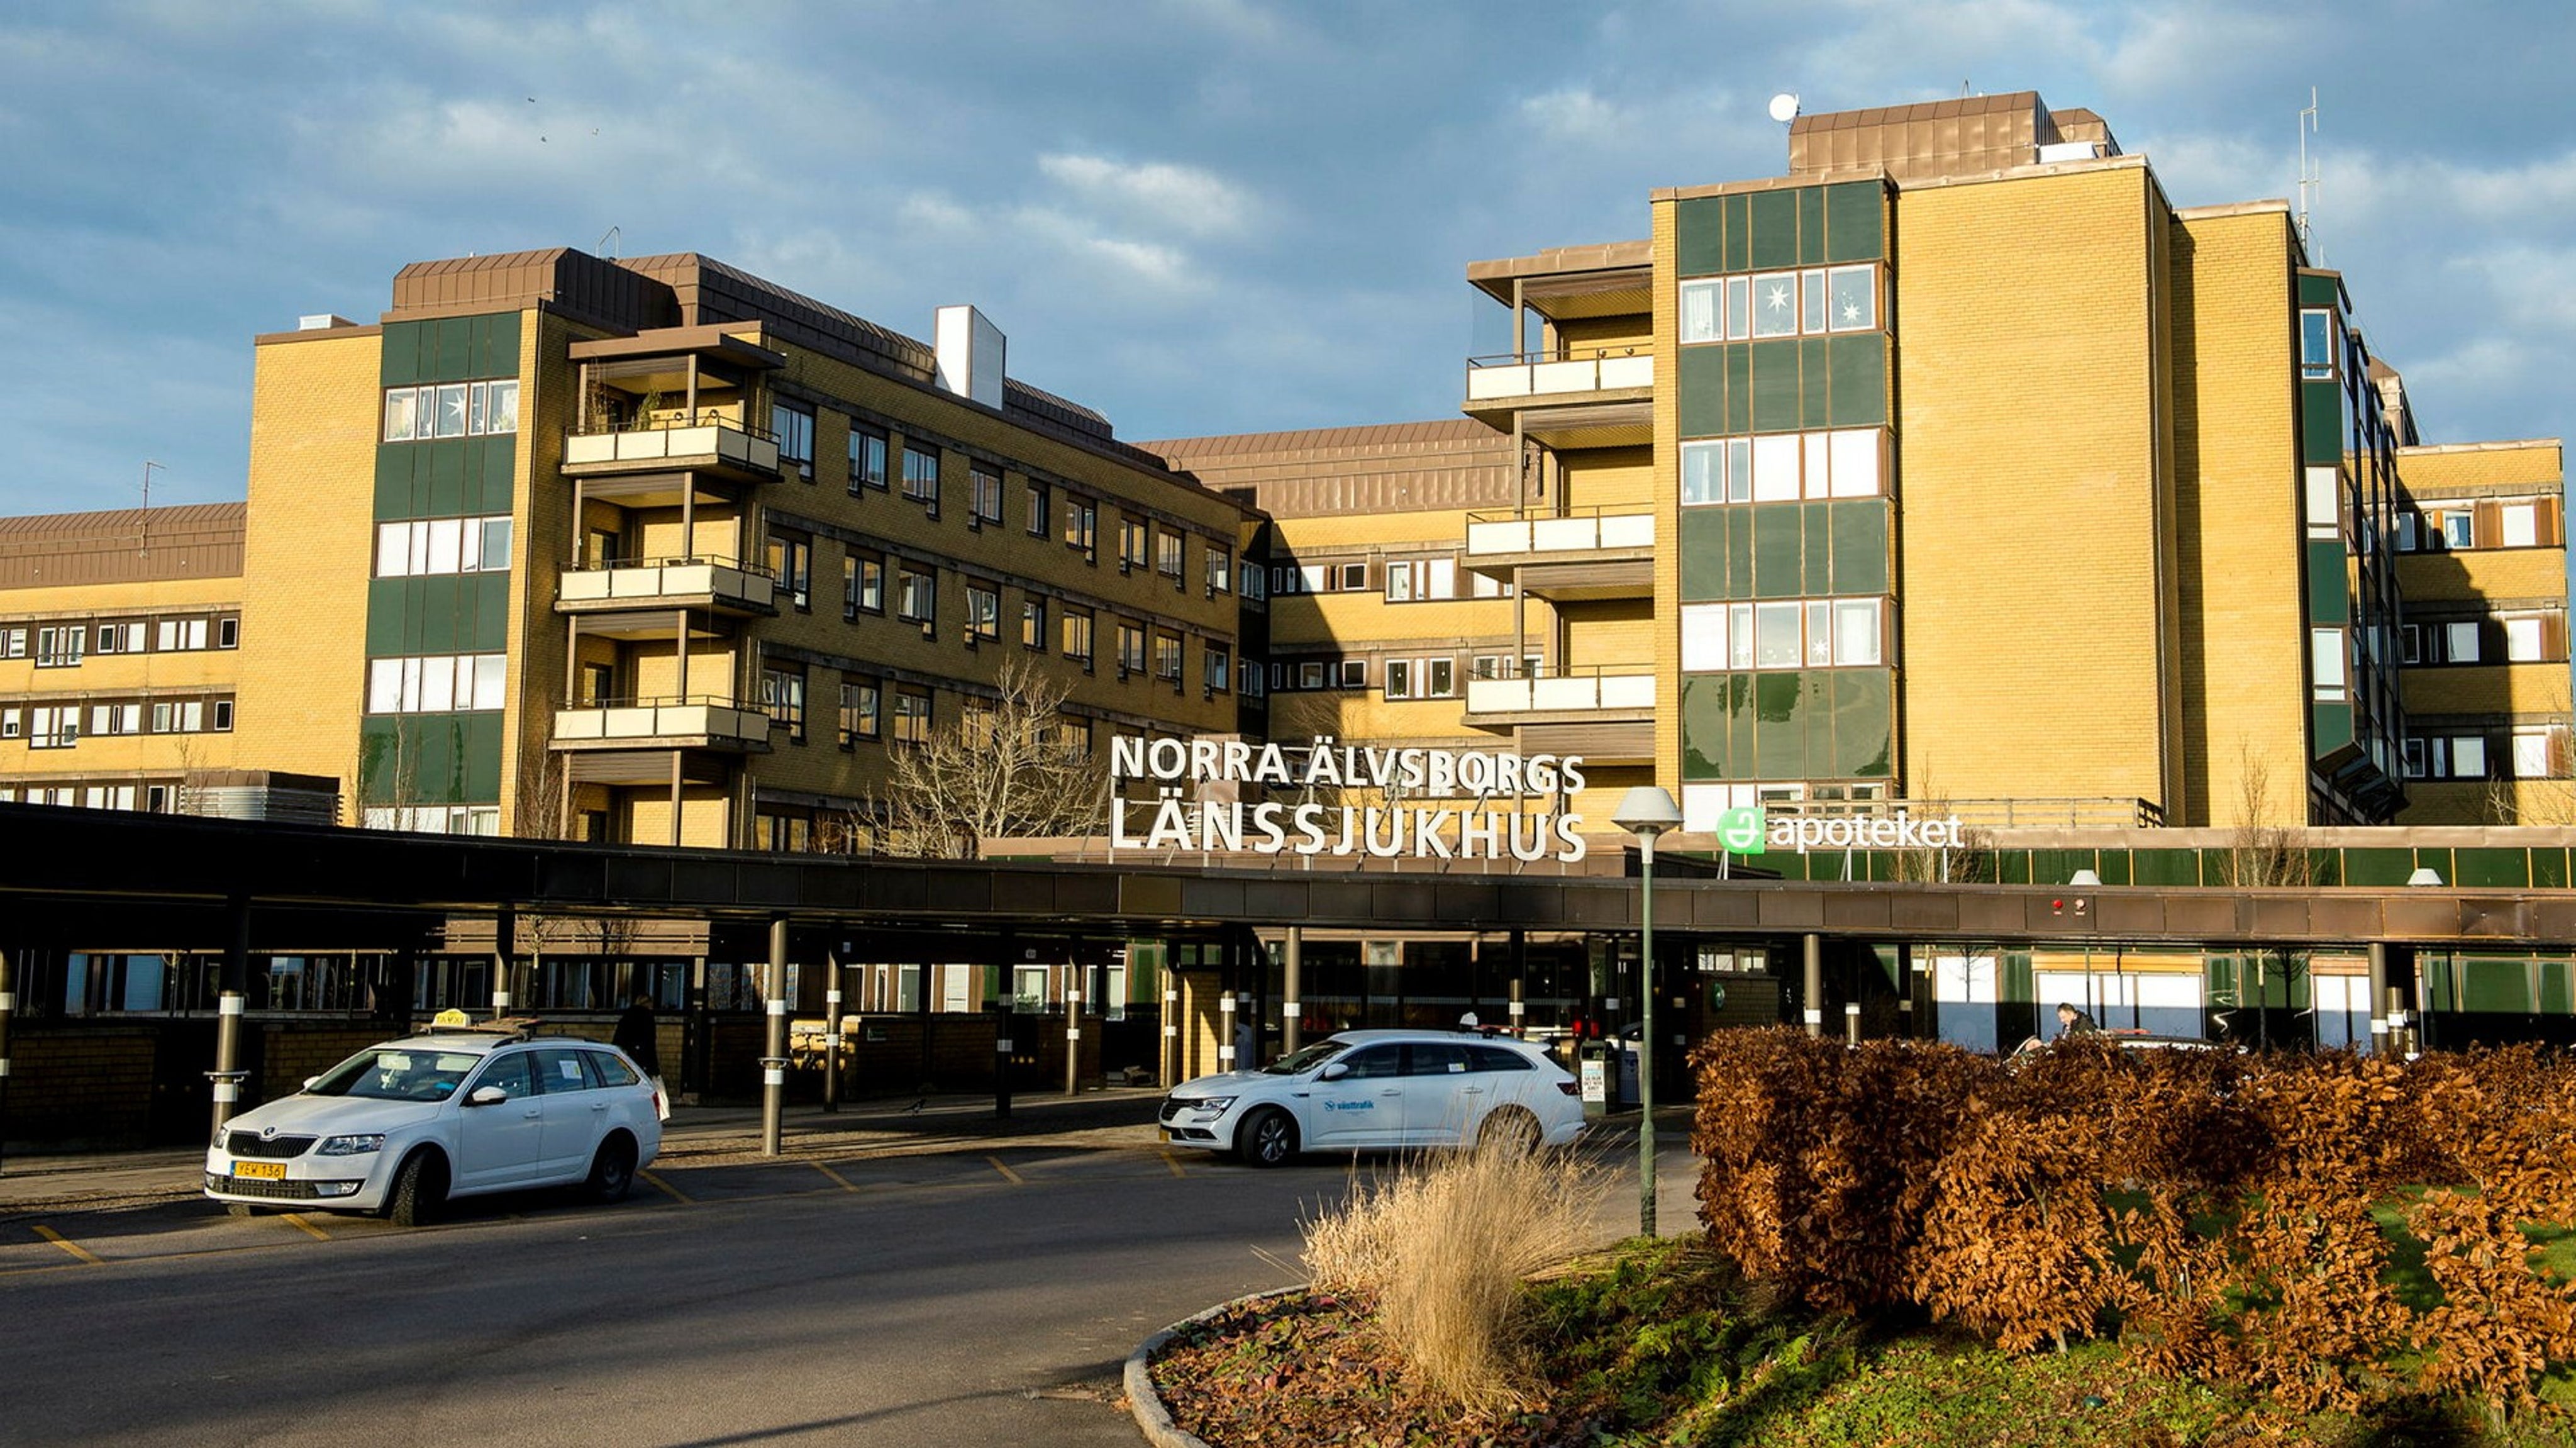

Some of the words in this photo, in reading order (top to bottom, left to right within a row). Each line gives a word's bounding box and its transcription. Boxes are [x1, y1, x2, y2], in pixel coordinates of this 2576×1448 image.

[1111, 737, 1290, 784] NORRA
[1304, 735, 1585, 794] ÄLVSBORGS
[1111, 787, 1586, 862] LÄNSSJUKHUS
[1771, 810, 1965, 854] apoteket
[262, 1165, 280, 1178] 136
